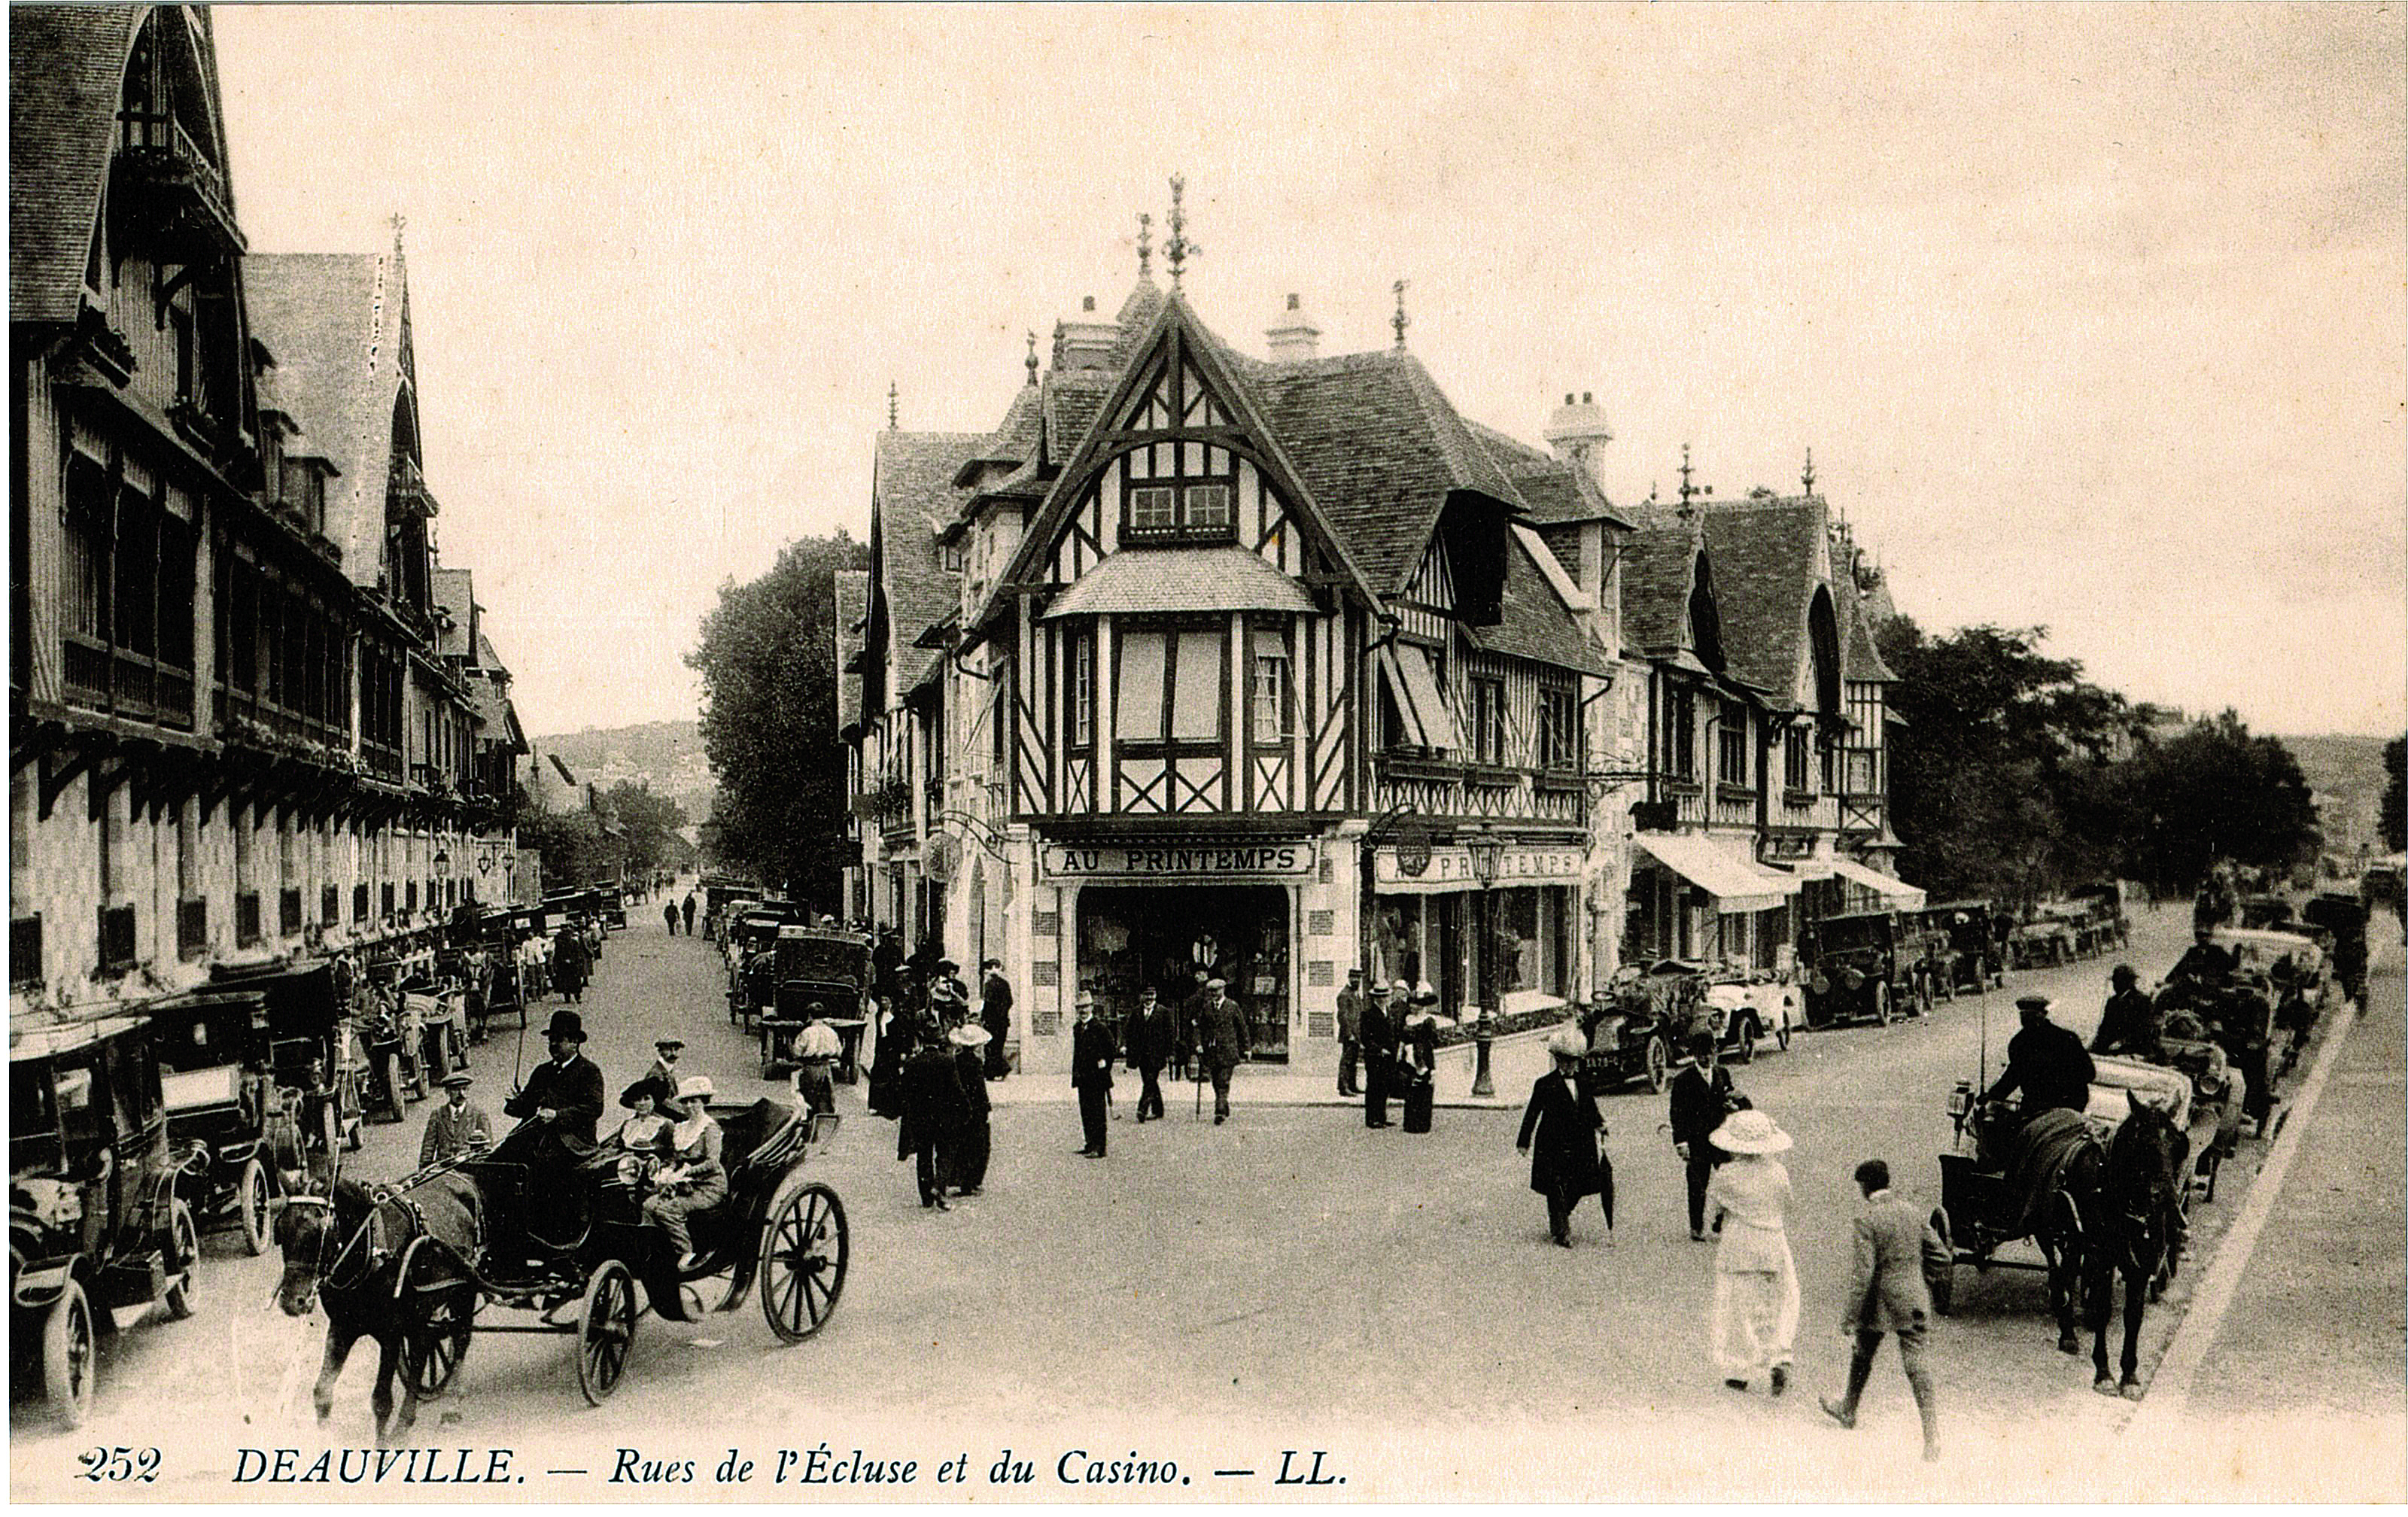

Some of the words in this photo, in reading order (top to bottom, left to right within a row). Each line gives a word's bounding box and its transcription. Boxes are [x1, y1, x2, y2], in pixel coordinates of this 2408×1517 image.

[1063, 850, 1099, 871] AU
[1126, 848, 1296, 871] PRINTEMPS
[1440, 855, 1571, 877] PRTEMPS
